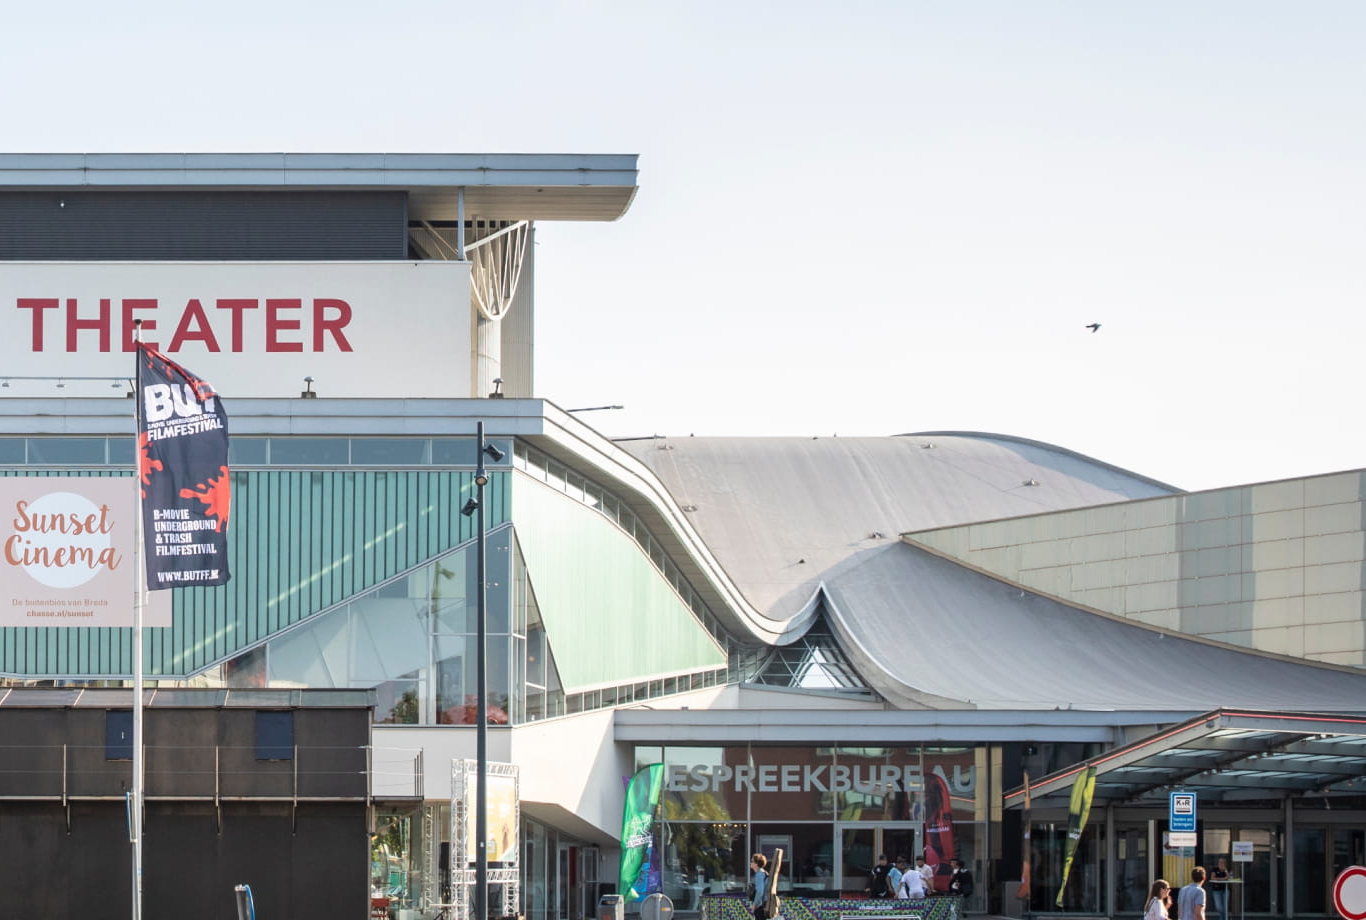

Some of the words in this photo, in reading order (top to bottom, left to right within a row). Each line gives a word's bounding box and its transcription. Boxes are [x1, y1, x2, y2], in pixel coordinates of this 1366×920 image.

[17, 298, 354, 353] THEATER
[147, 418, 223, 441] FILMFESTIVAL
[13, 500, 115, 535] Sunset
[153, 509, 190, 520] B-MOVIE
[154, 519, 217, 532] UNDERGROUND
[155, 533, 163, 543] &
[164, 533, 192, 543] TRASH
[4, 534, 122, 571] Cinema
[155, 544, 217, 556] FILMFESTIVAL
[666, 764, 976, 792] ESPREEKBUREAU
